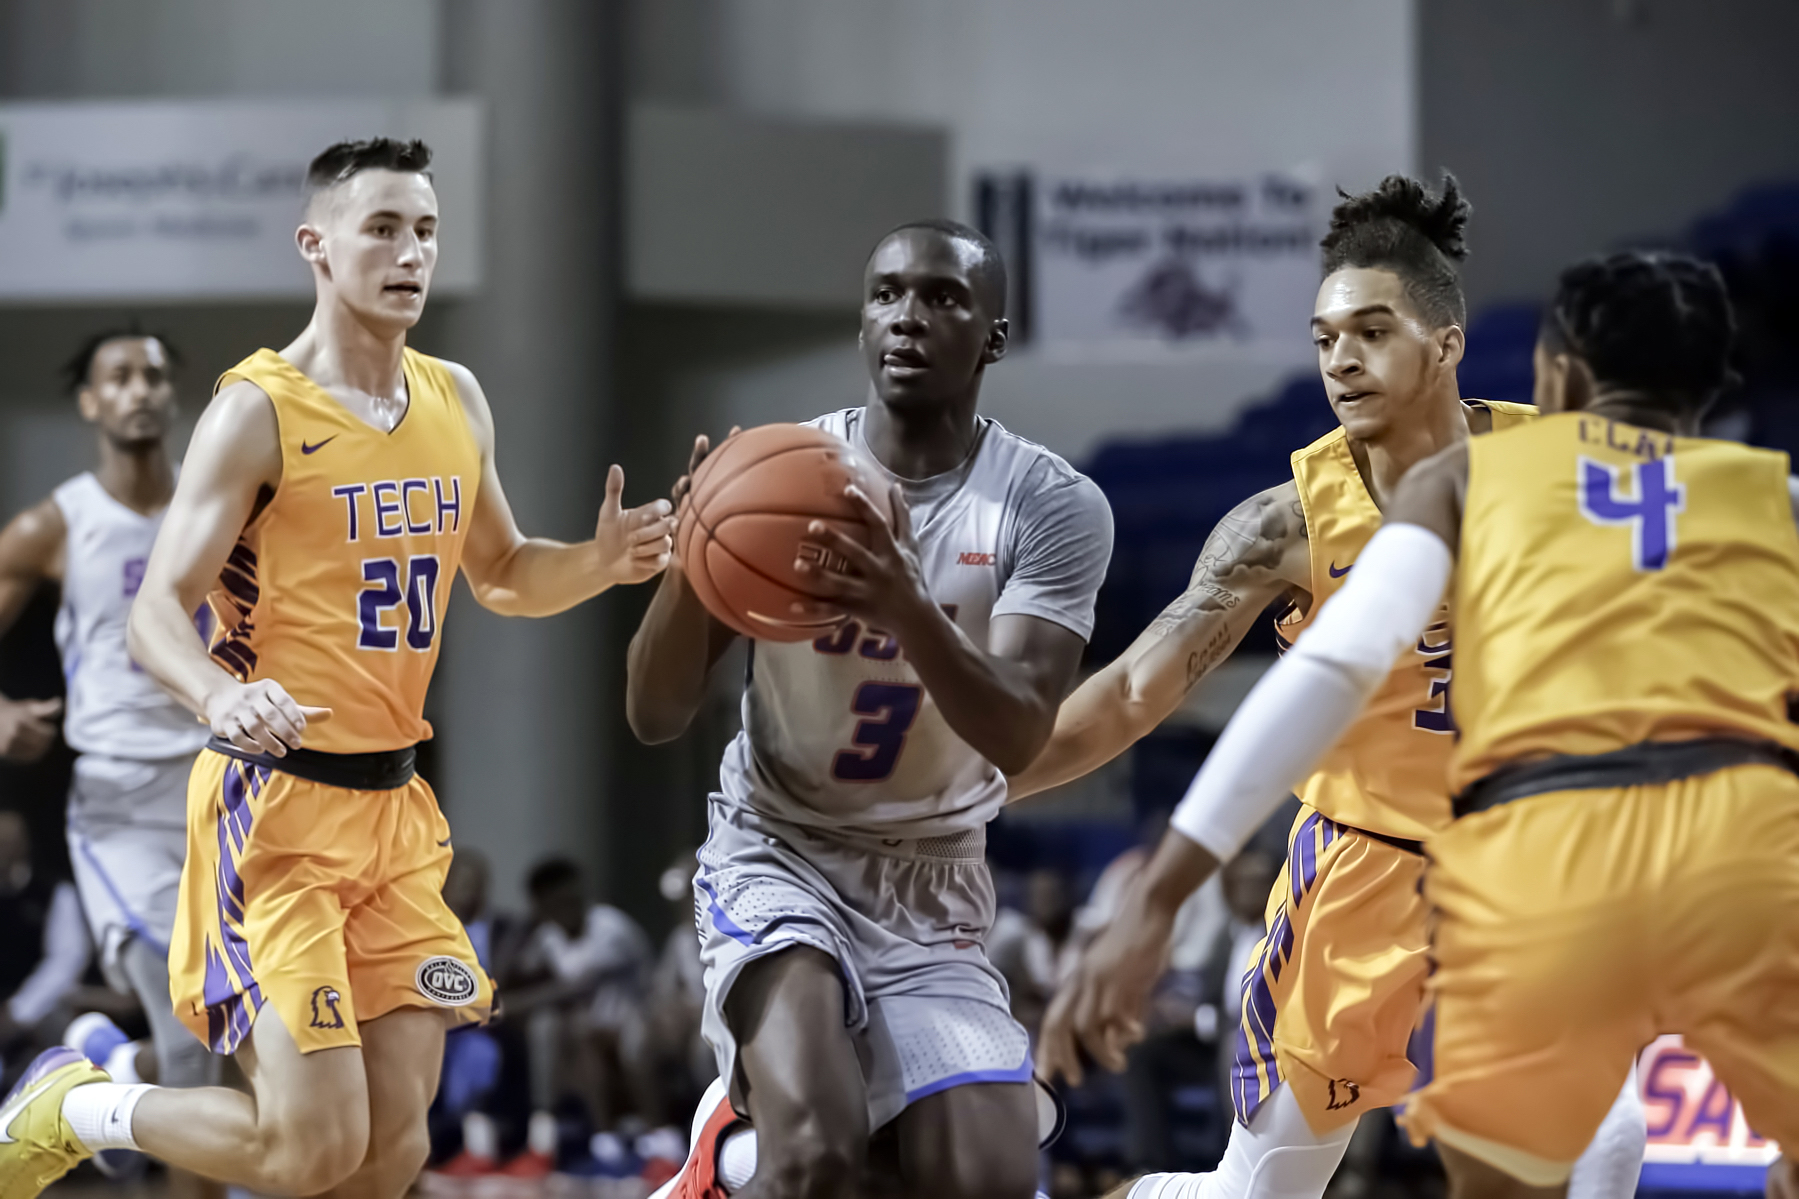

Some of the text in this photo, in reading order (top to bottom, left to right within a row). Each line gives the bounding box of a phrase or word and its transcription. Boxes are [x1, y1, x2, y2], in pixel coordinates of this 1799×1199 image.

[331, 475, 461, 544] TECH
[1577, 453, 1687, 572] 4
[356, 553, 441, 653] 20
[830, 679, 926, 785] 3
[431, 971, 465, 991] OVC
